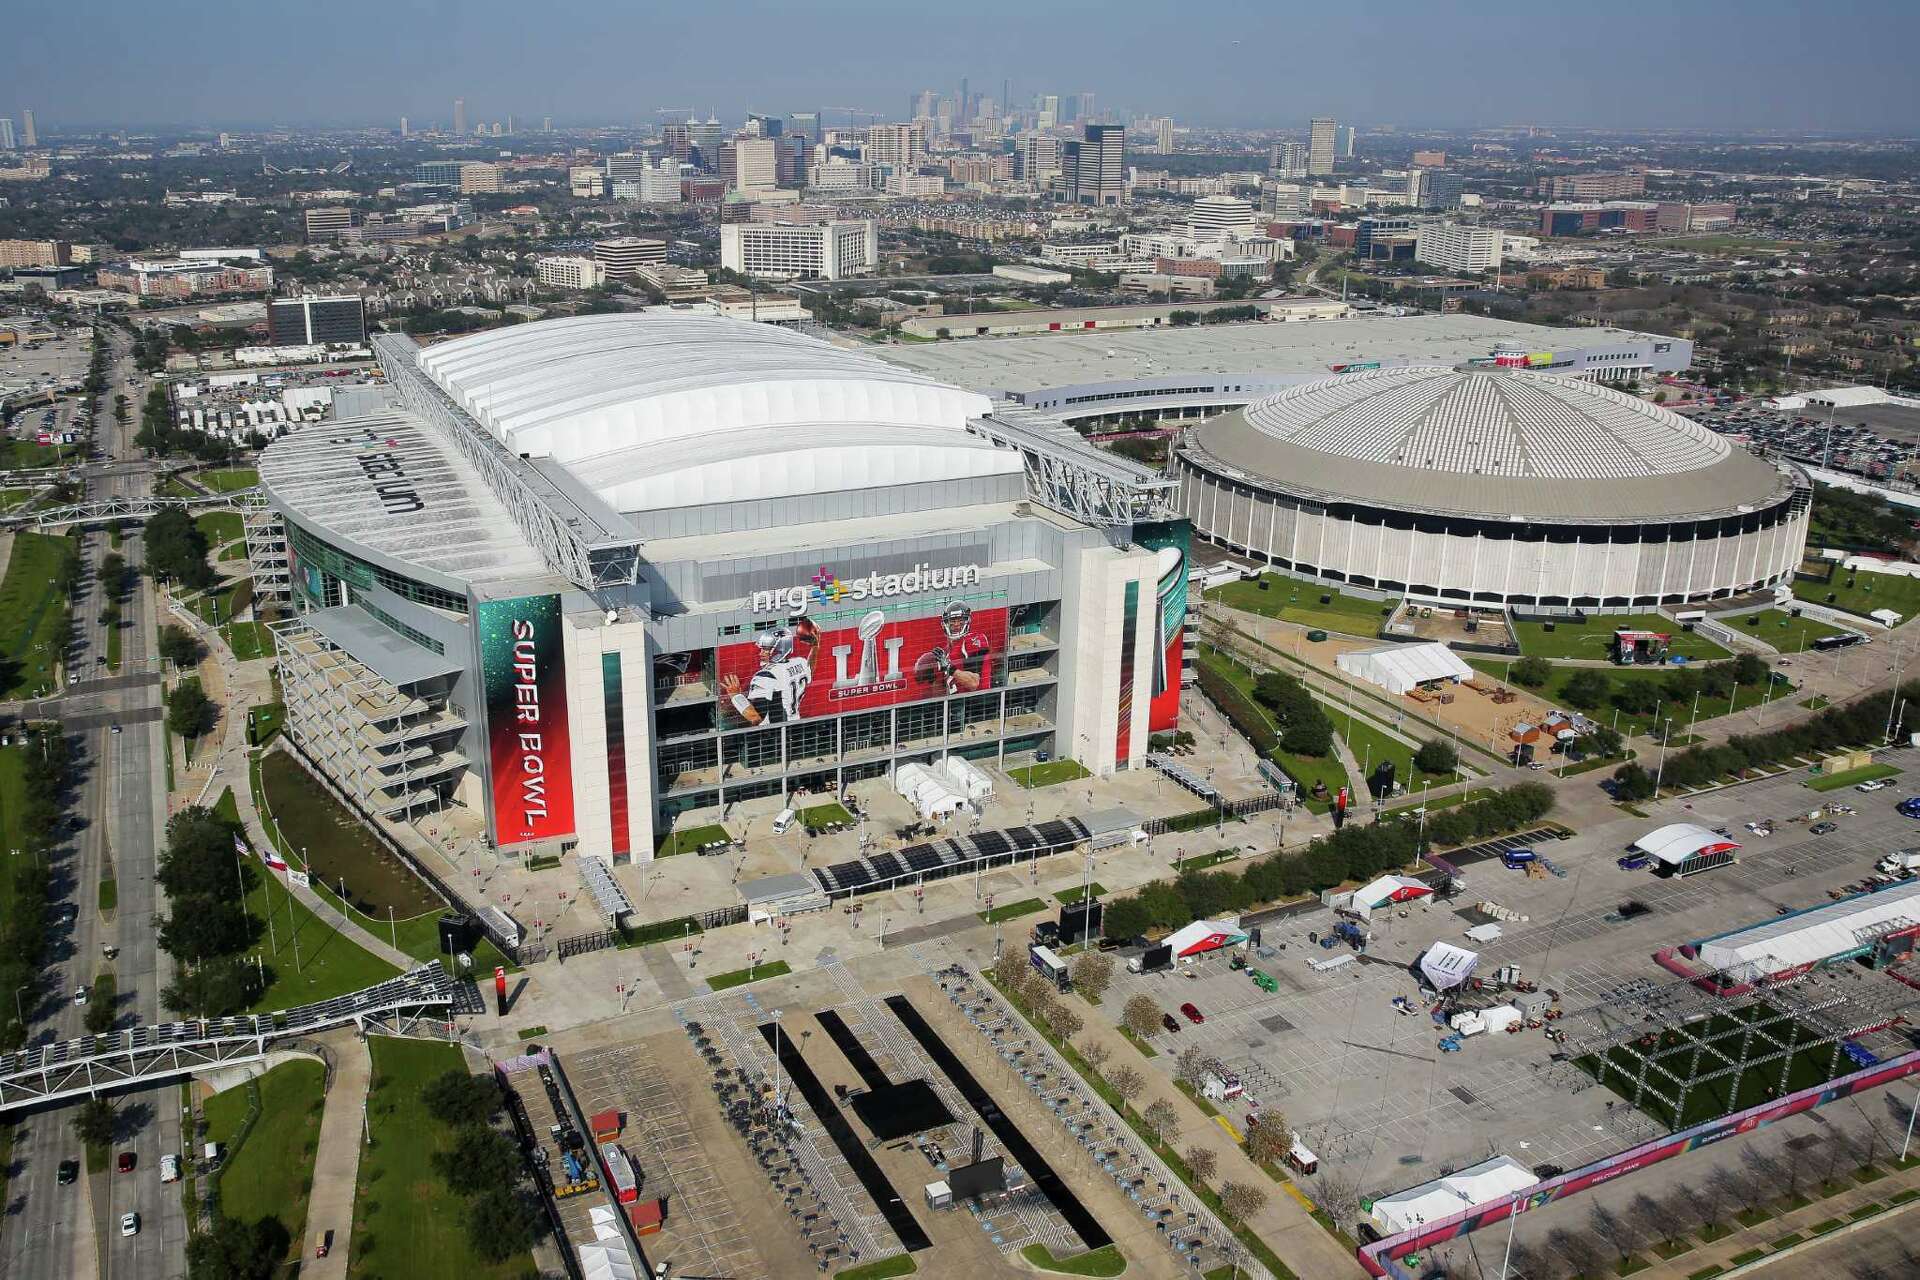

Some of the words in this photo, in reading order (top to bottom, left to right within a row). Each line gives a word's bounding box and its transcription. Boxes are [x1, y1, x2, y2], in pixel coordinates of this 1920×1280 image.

[752, 585, 808, 617] nrg
[852, 562, 981, 600] stadium
[512, 619, 540, 725] SUPER
[832, 636, 904, 689] LI
[790, 675, 809, 714] 12
[837, 686, 869, 699] SUPER
[872, 682, 899, 694] BOWL
[518, 733, 548, 828] BOWL
[1592, 1168, 1622, 1183] WELCOME
